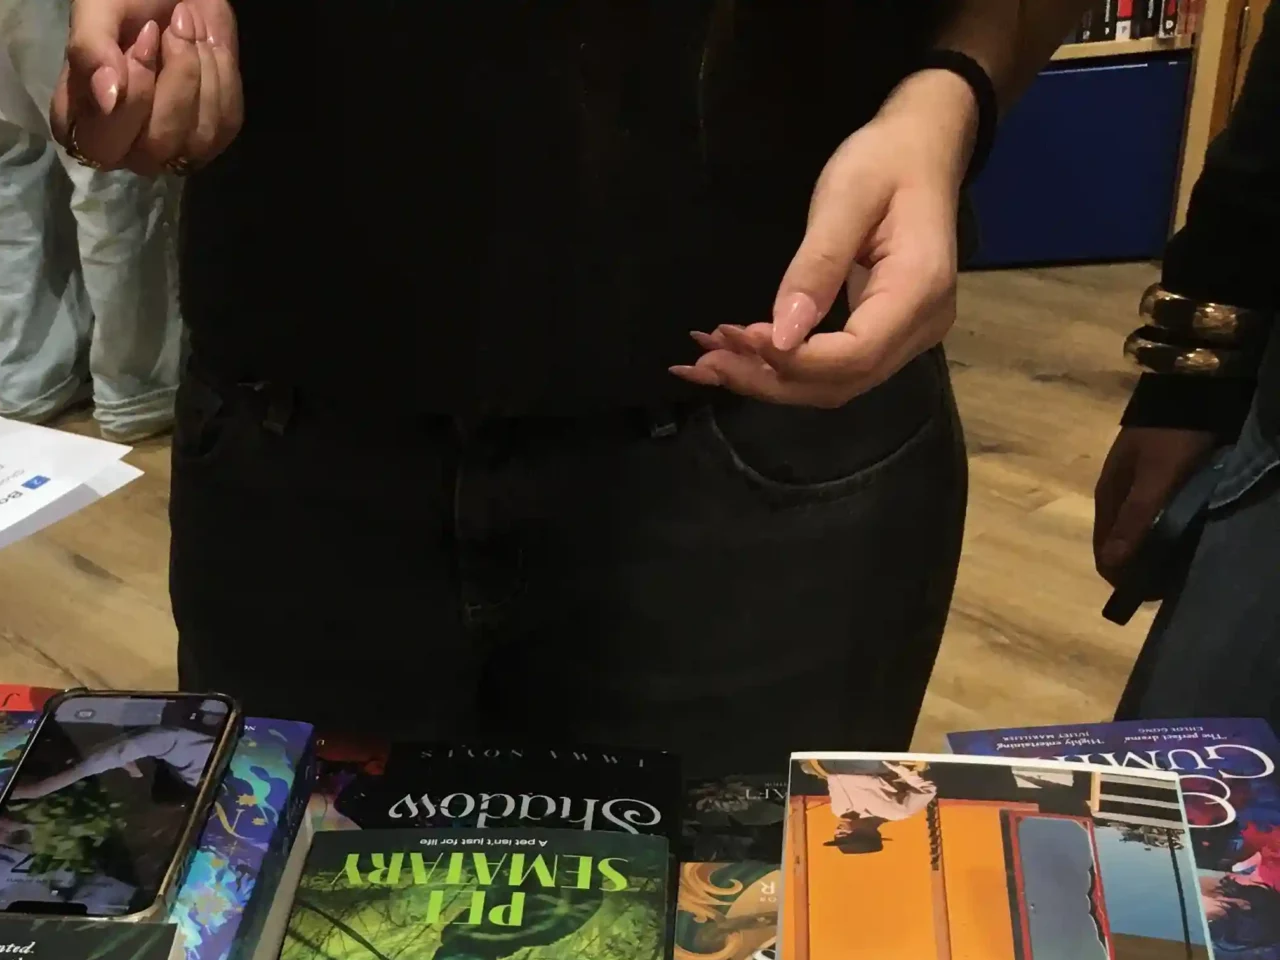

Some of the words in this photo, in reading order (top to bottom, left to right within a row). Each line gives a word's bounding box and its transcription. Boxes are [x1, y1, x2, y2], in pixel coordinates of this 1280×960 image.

[387, 791, 662, 835] Shadow
[418, 837, 437, 846] life
[439, 837, 458, 846] for
[460, 835, 483, 846] just
[485, 836, 513, 847] isn't
[515, 836, 536, 846] pet
[538, 837, 547, 846] A
[331, 852, 630, 893] SEMATARY
[423, 889, 525, 927] PET
